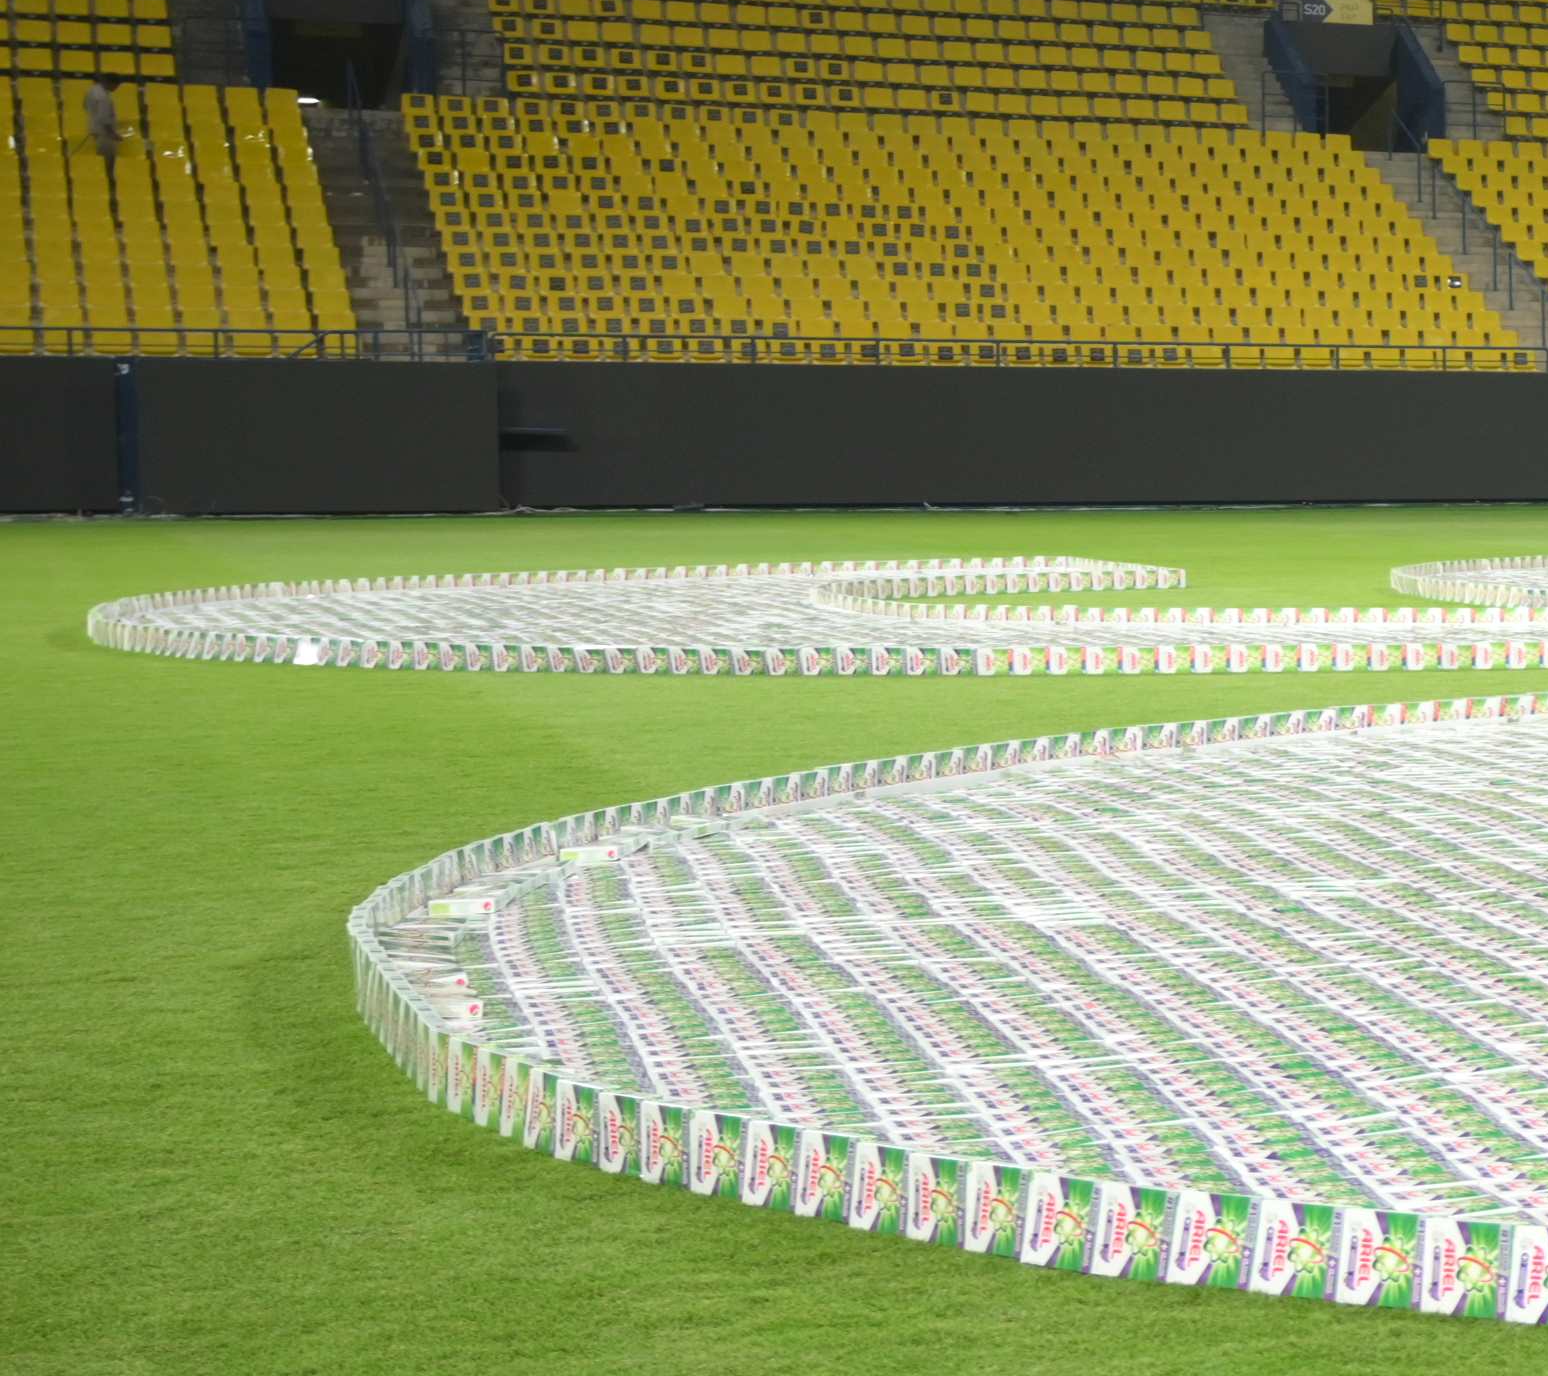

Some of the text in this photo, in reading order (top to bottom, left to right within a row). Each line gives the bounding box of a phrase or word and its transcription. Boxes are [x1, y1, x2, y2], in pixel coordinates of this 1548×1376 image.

[1303, 3, 1326, 16] S20
[703, 1128, 713, 1177] ARIEL
[757, 1138, 768, 1187] ARIEL
[809, 1148, 820, 1198] ARIEL
[864, 1161, 875, 1211] ARIEL
[980, 1180, 991, 1232] ARIEL
[1040, 1192, 1055, 1245] ARIEL
[1111, 1202, 1125, 1256] ARIEL
[1188, 1209, 1206, 1264] ARIEL
[1271, 1219, 1289, 1275] ARIEL
[1357, 1228, 1374, 1283] ARIEL
[1441, 1238, 1457, 1295] ARIEL
[1528, 1246, 1545, 1301] ARIEL
